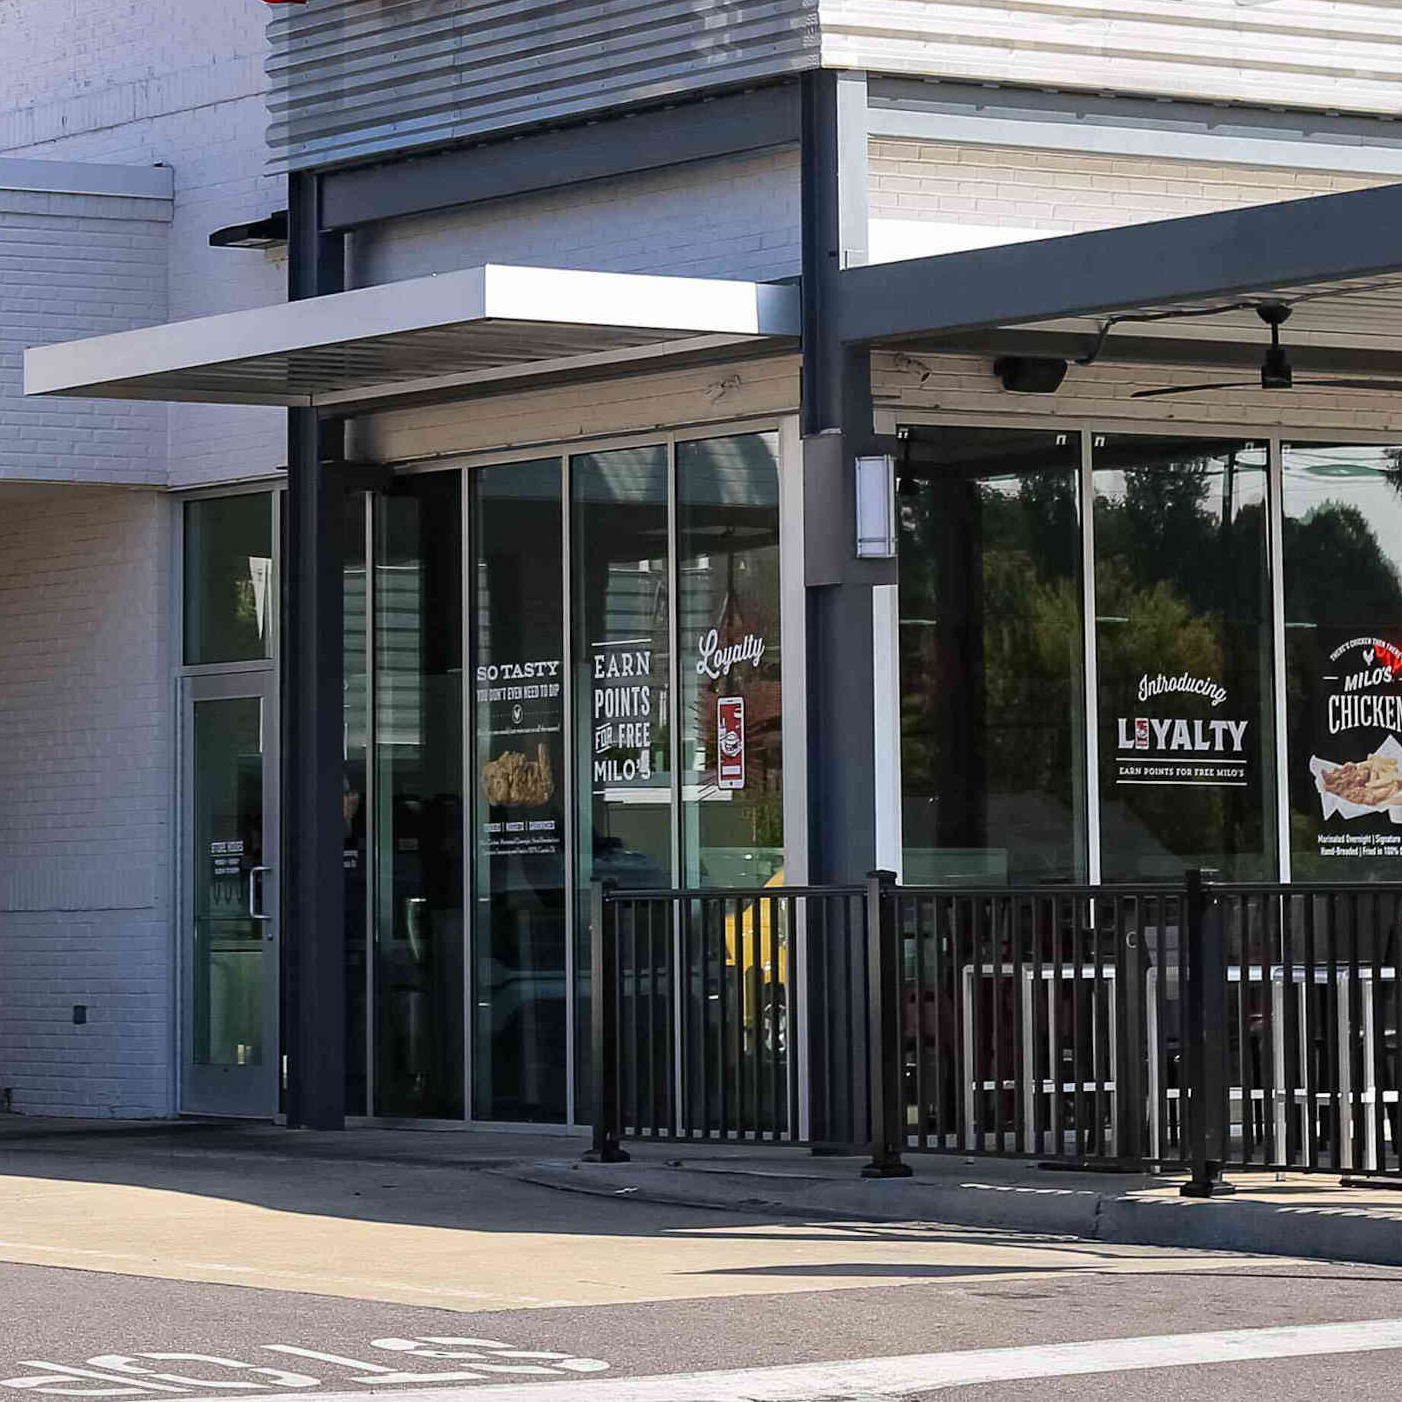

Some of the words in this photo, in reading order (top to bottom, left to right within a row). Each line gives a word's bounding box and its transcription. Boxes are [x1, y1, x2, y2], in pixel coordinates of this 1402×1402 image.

[594, 651, 651, 679] EARN
[696, 629, 766, 679] Loyalty
[477, 665, 499, 681] SO
[500, 661, 560, 680] TASTY
[1344, 665, 1393, 692] MILO'S
[594, 685, 650, 719] POINTS
[1138, 671, 1227, 706] Introducing
[595, 727, 614, 751] FOR
[618, 722, 651, 749] FREE
[1119, 766, 1141, 775] EARN
[1143, 766, 1174, 776] POINTS
[1176, 767, 1192, 776] FOR
[1194, 768, 1215, 777] FREE
[1216, 768, 1244, 777] MILO'S
